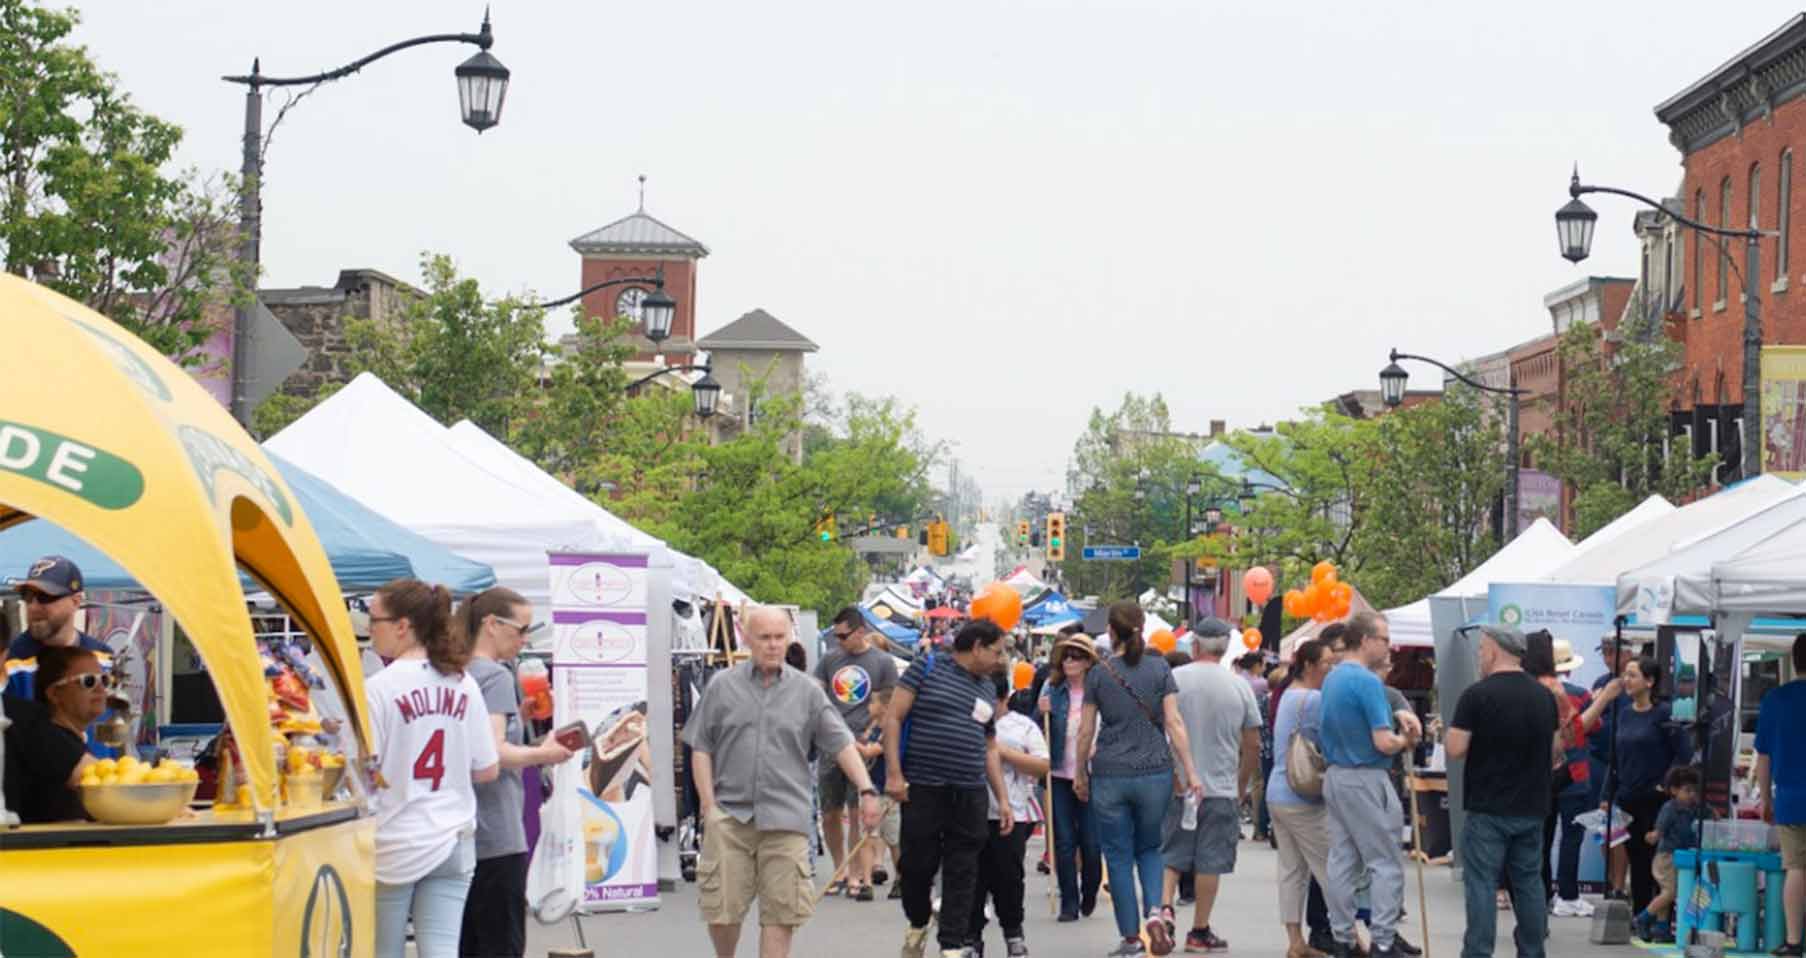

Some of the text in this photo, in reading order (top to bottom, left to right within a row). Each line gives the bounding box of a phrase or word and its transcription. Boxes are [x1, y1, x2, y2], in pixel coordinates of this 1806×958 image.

[394, 686, 468, 724] MOLINA
[413, 728, 445, 792] 4
[603, 885, 643, 900] Natural
